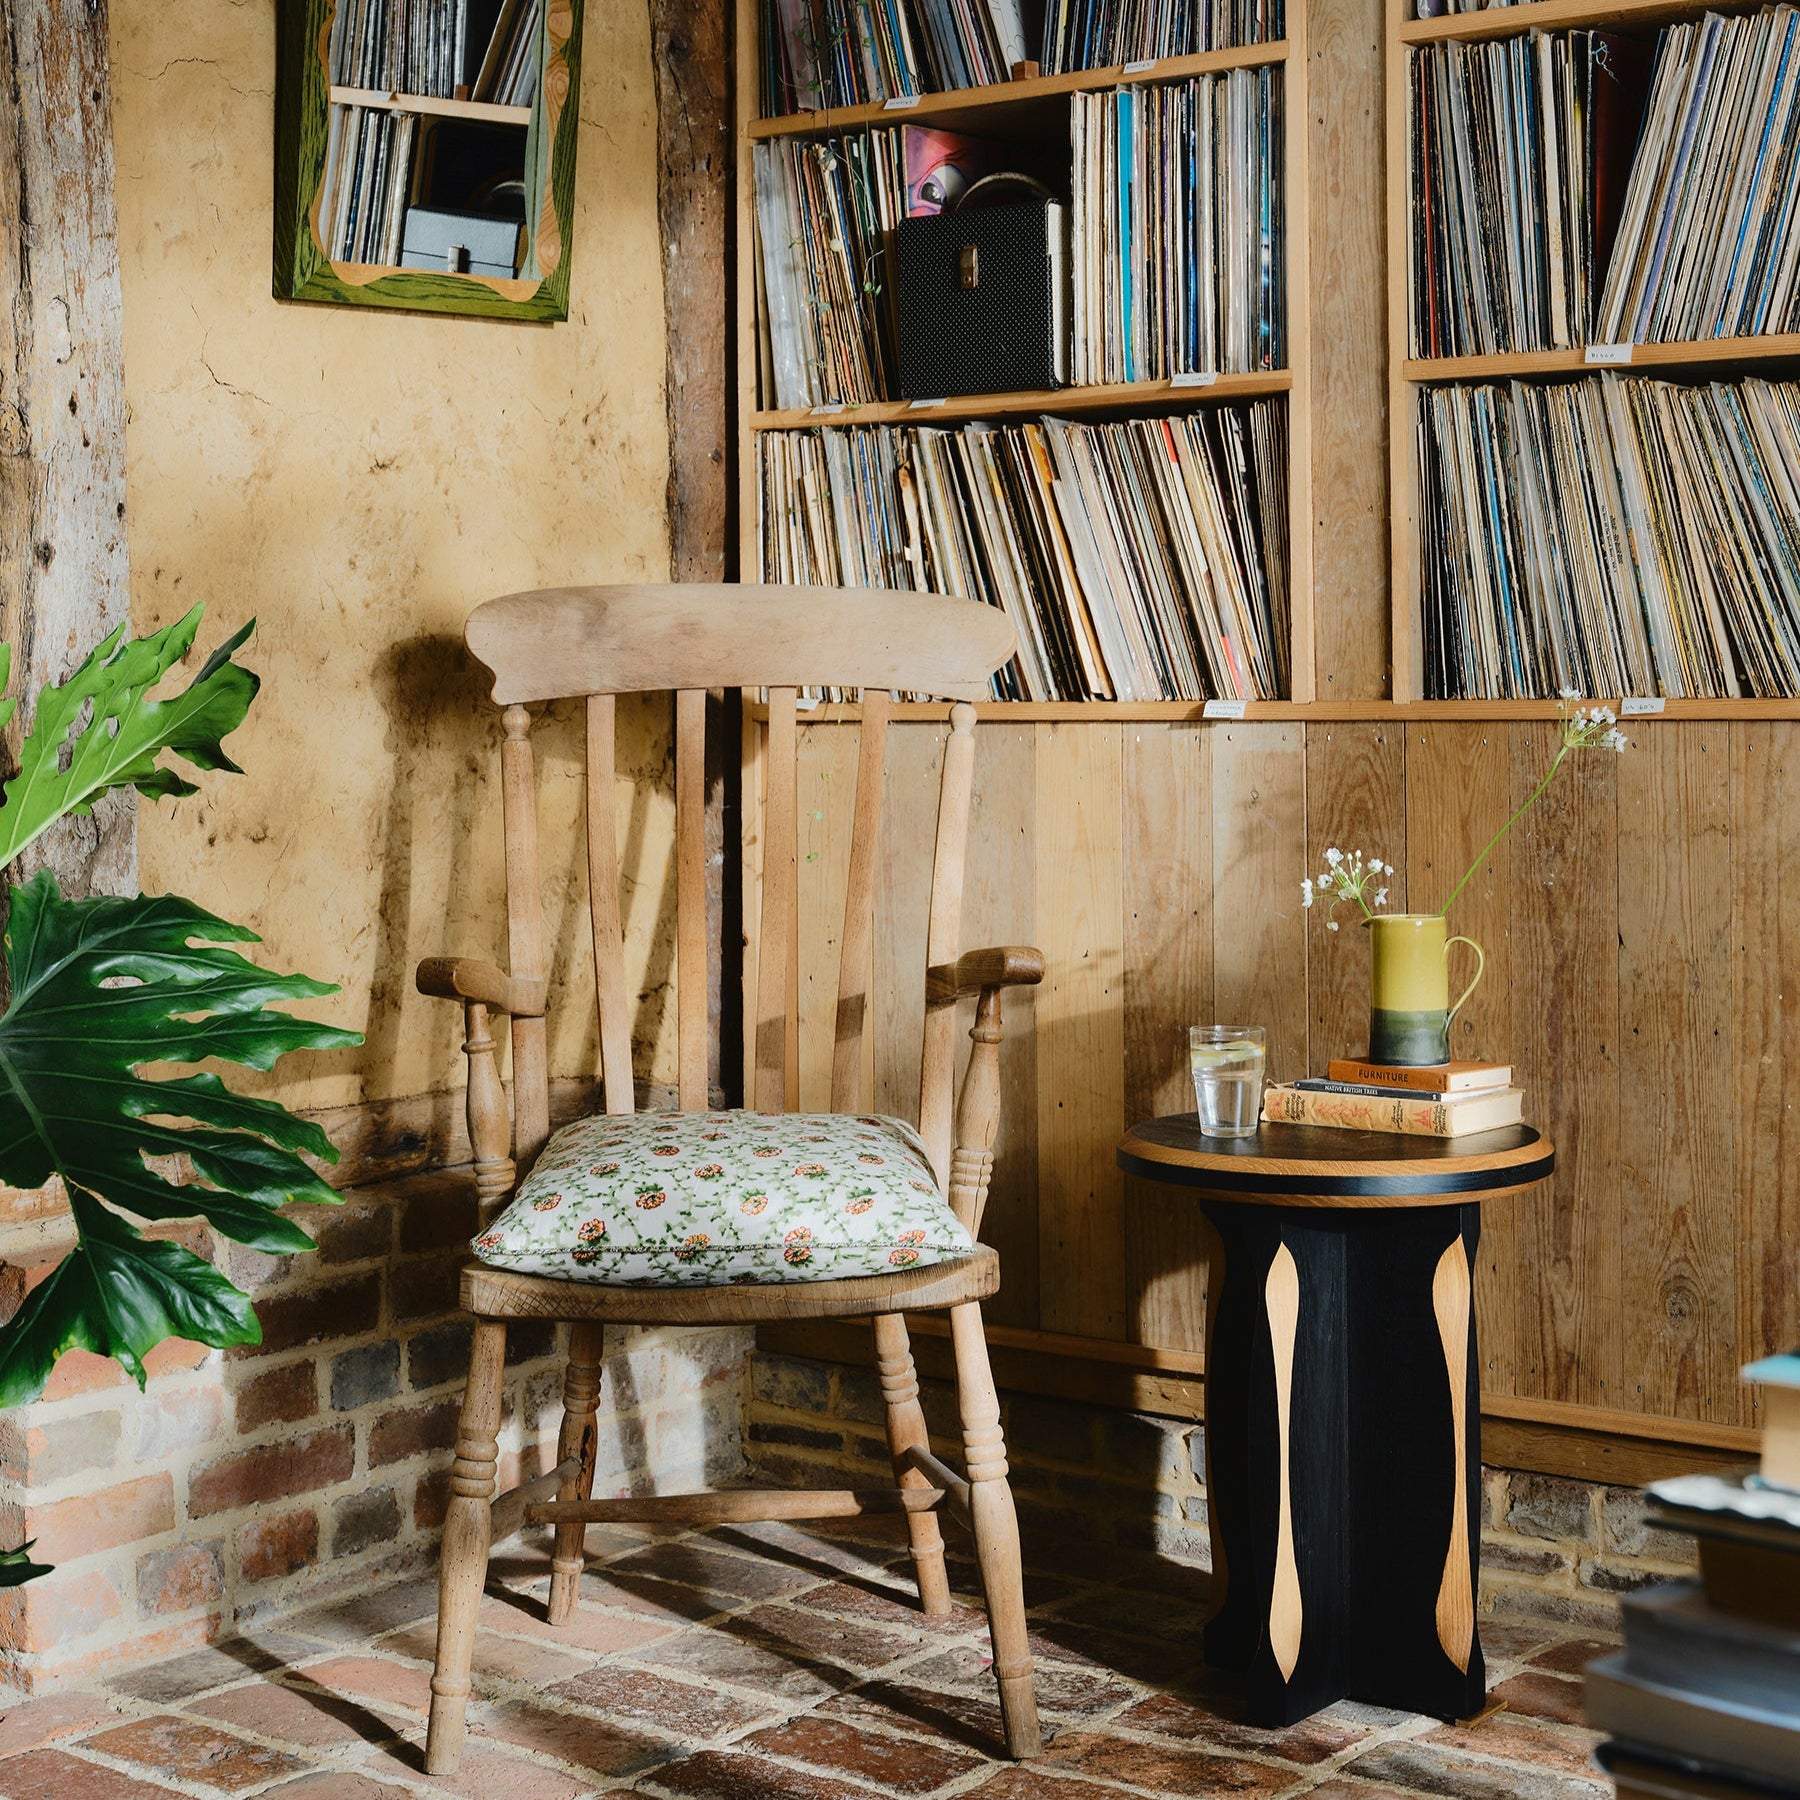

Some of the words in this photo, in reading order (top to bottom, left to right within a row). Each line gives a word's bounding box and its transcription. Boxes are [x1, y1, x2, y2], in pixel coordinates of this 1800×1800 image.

[1358, 1069, 1409, 1082] FURNITURE
[1324, 1084, 1343, 1093] NATIVE
[1343, 1086, 1363, 1094] BRITISH
